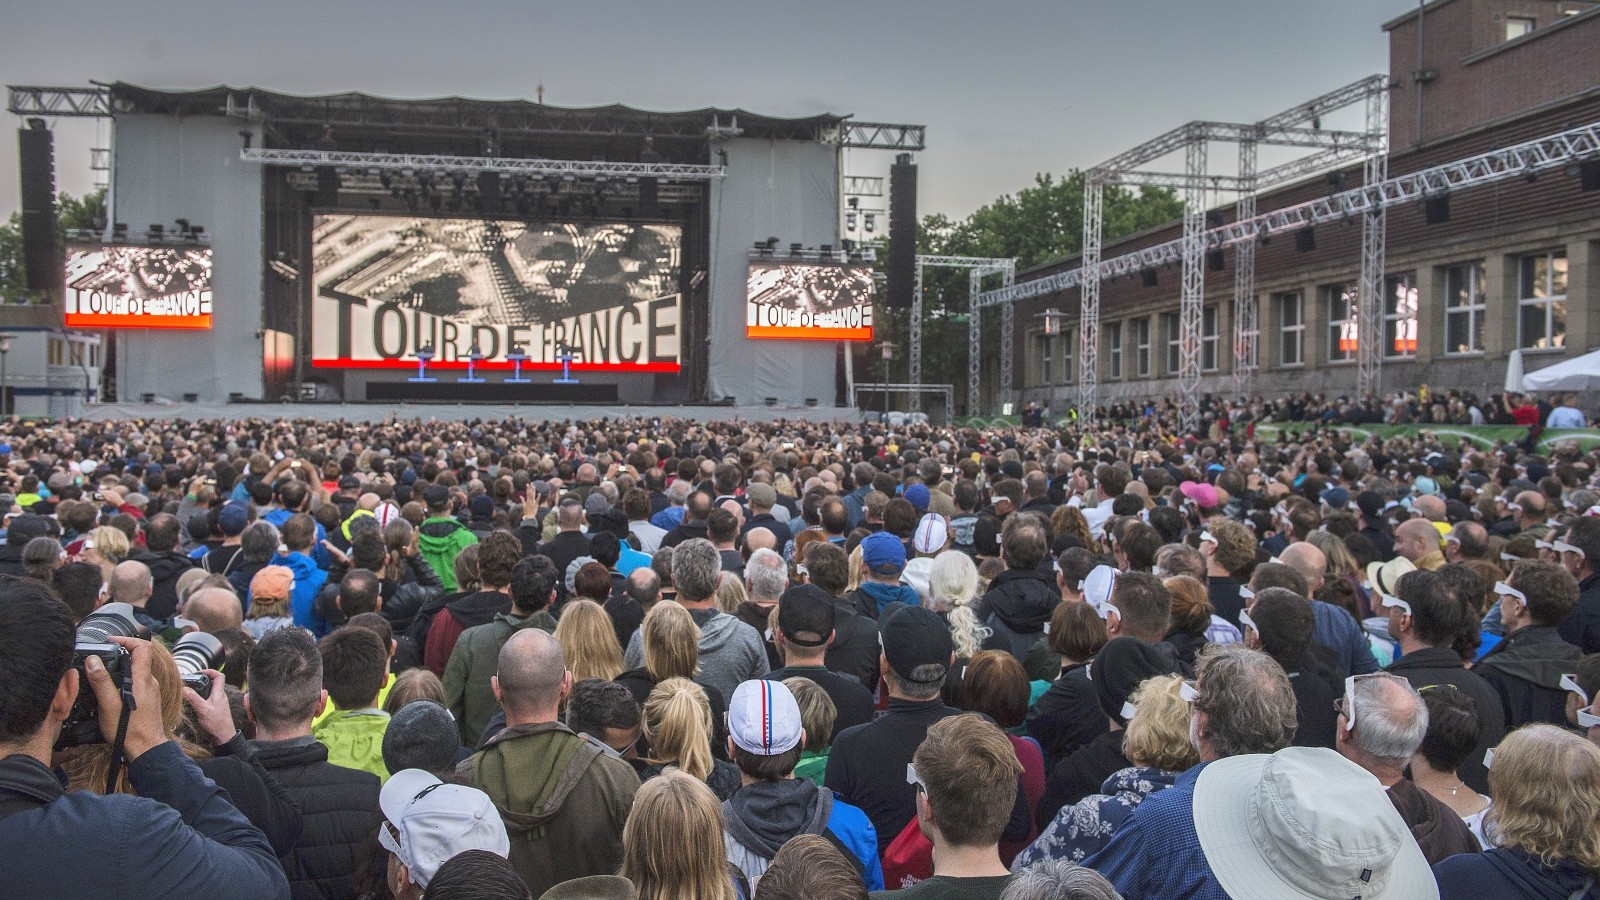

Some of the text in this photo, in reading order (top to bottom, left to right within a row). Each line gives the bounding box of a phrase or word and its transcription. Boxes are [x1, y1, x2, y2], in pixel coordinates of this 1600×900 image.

[128, 298, 151, 315] DE
[153, 288, 212, 316] ANCE
[823, 302, 872, 328] ANCE
[319, 285, 678, 362] TOUR DE FRANCE
